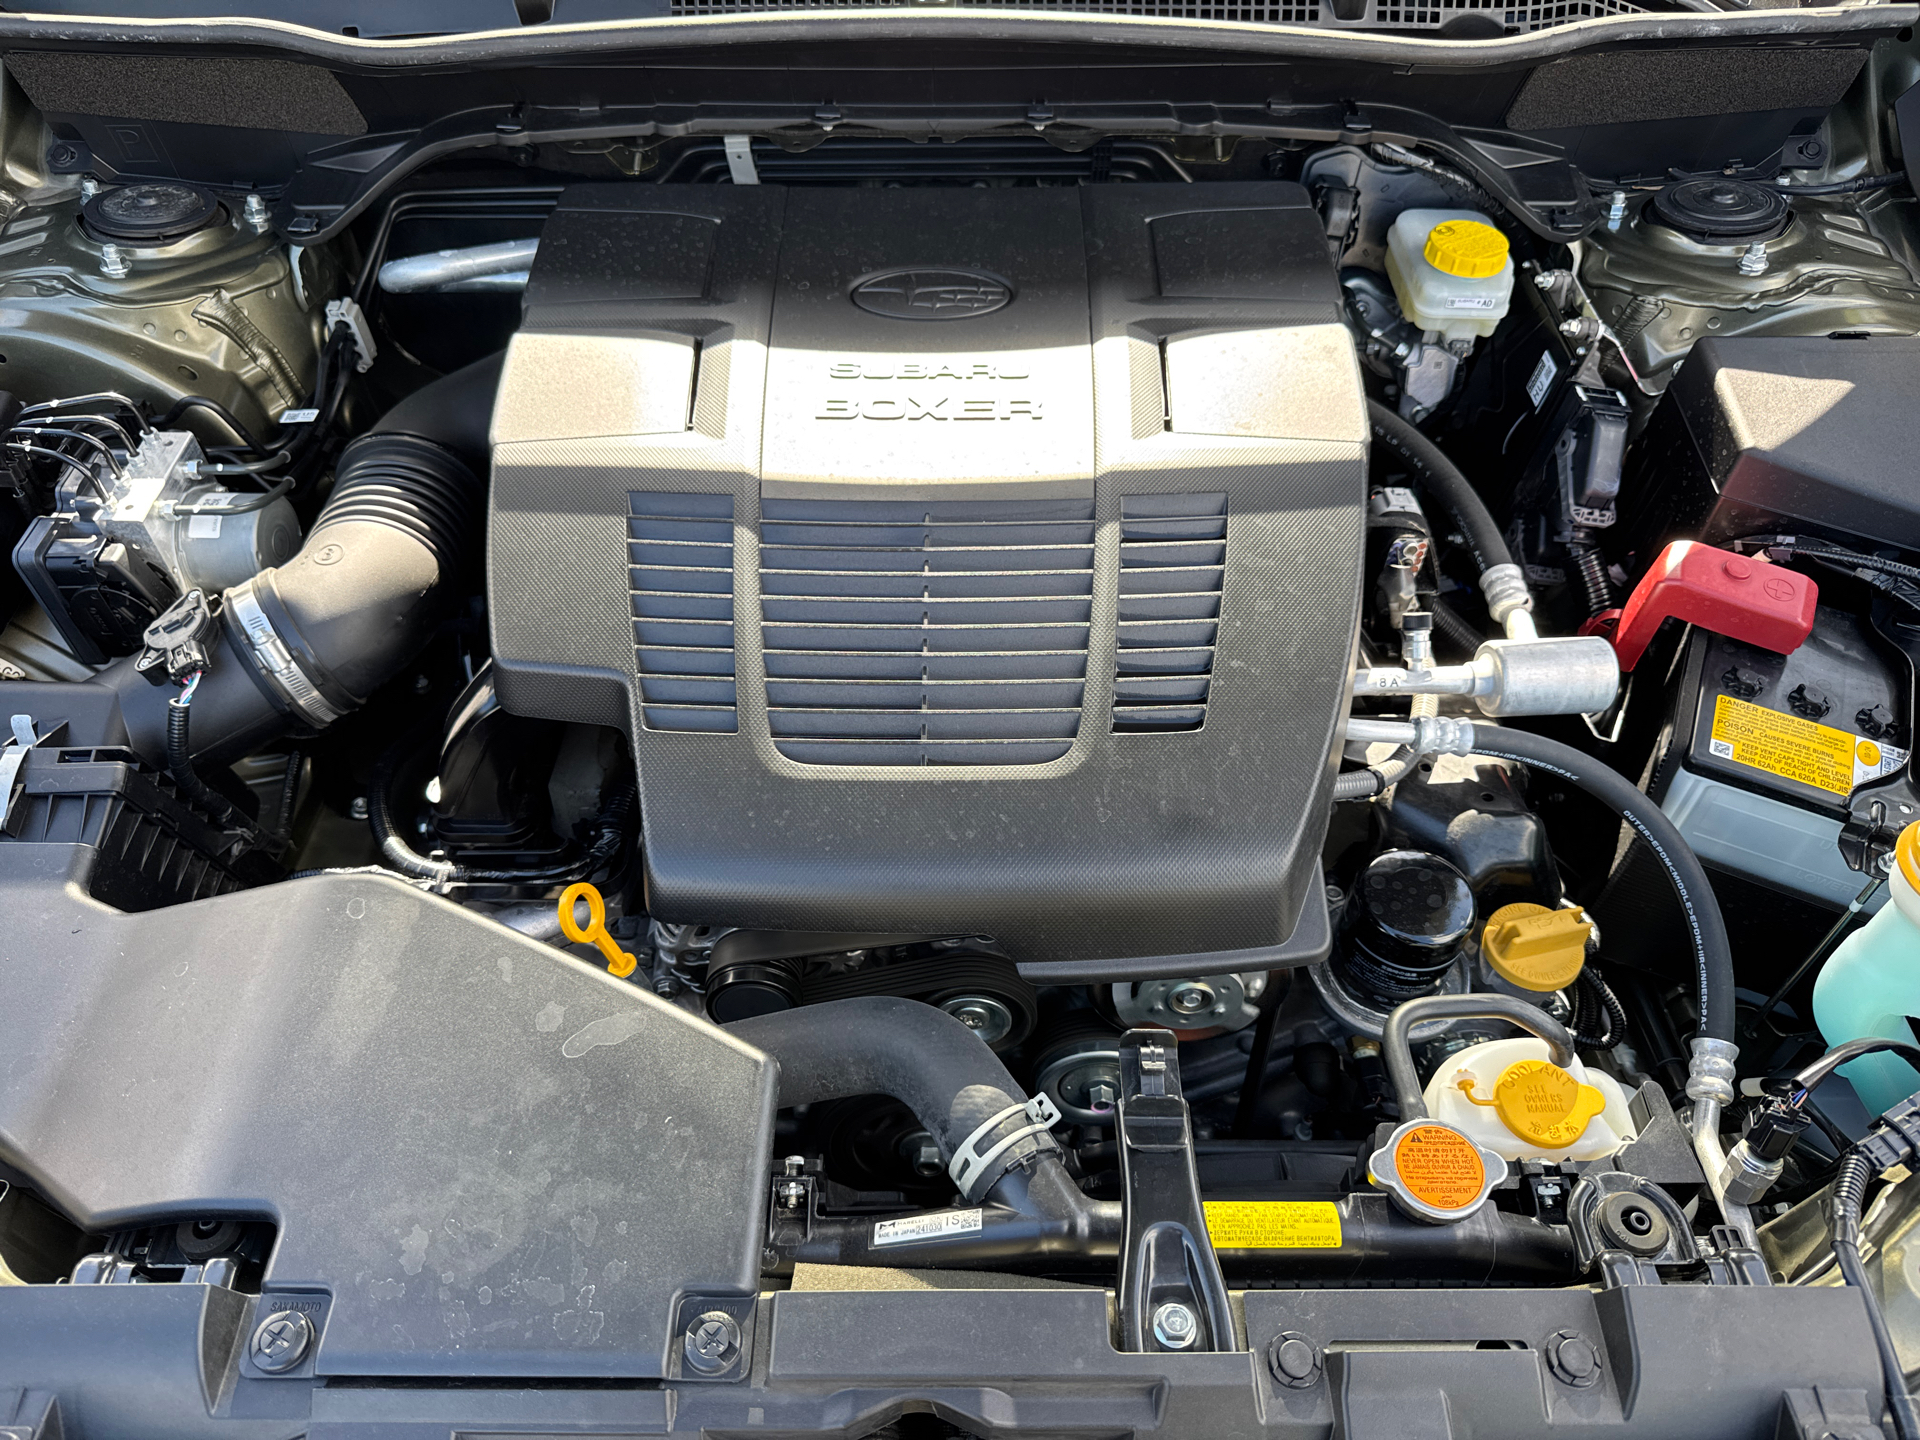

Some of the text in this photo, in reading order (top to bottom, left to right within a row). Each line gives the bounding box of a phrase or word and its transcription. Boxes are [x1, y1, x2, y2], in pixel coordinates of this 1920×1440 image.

[830, 362, 1030, 379] SUBARU
[815, 397, 1043, 420] BOXER
[1720, 697, 1759, 713] DANGER
[1761, 710, 1795, 724] EXPLOSIVE
[1797, 721, 1818, 731] GASES
[1717, 718, 1754, 735] POISON
[1759, 732, 1784, 743] CAUSES
[1786, 740, 1811, 752] SEVERE
[1812, 748, 1834, 759] BURNS
[1736, 753, 1756, 765] 20HR
[1757, 760, 1777, 771] 62Ah
[1780, 766, 1797, 777] CCA
[1798, 772, 1817, 784] 620A
[1741, 748, 1758, 757] KEEP
[1784, 761, 1806, 772] REACH
[1818, 772, 1850, 786] CHILDREN
[1742, 742, 1851, 780] KEEP VENT CAPS TIGHT AND LEVEL
[1510, 962, 1527, 976] SEE
[1502, 1063, 1574, 1089] COOLANT
[1524, 1094, 1563, 1104] OWNERS
[1527, 1084, 1547, 1094] SEE
[1526, 1103, 1566, 1113] MANUAL
[270, 1301, 322, 1312] SAKAMOTO
